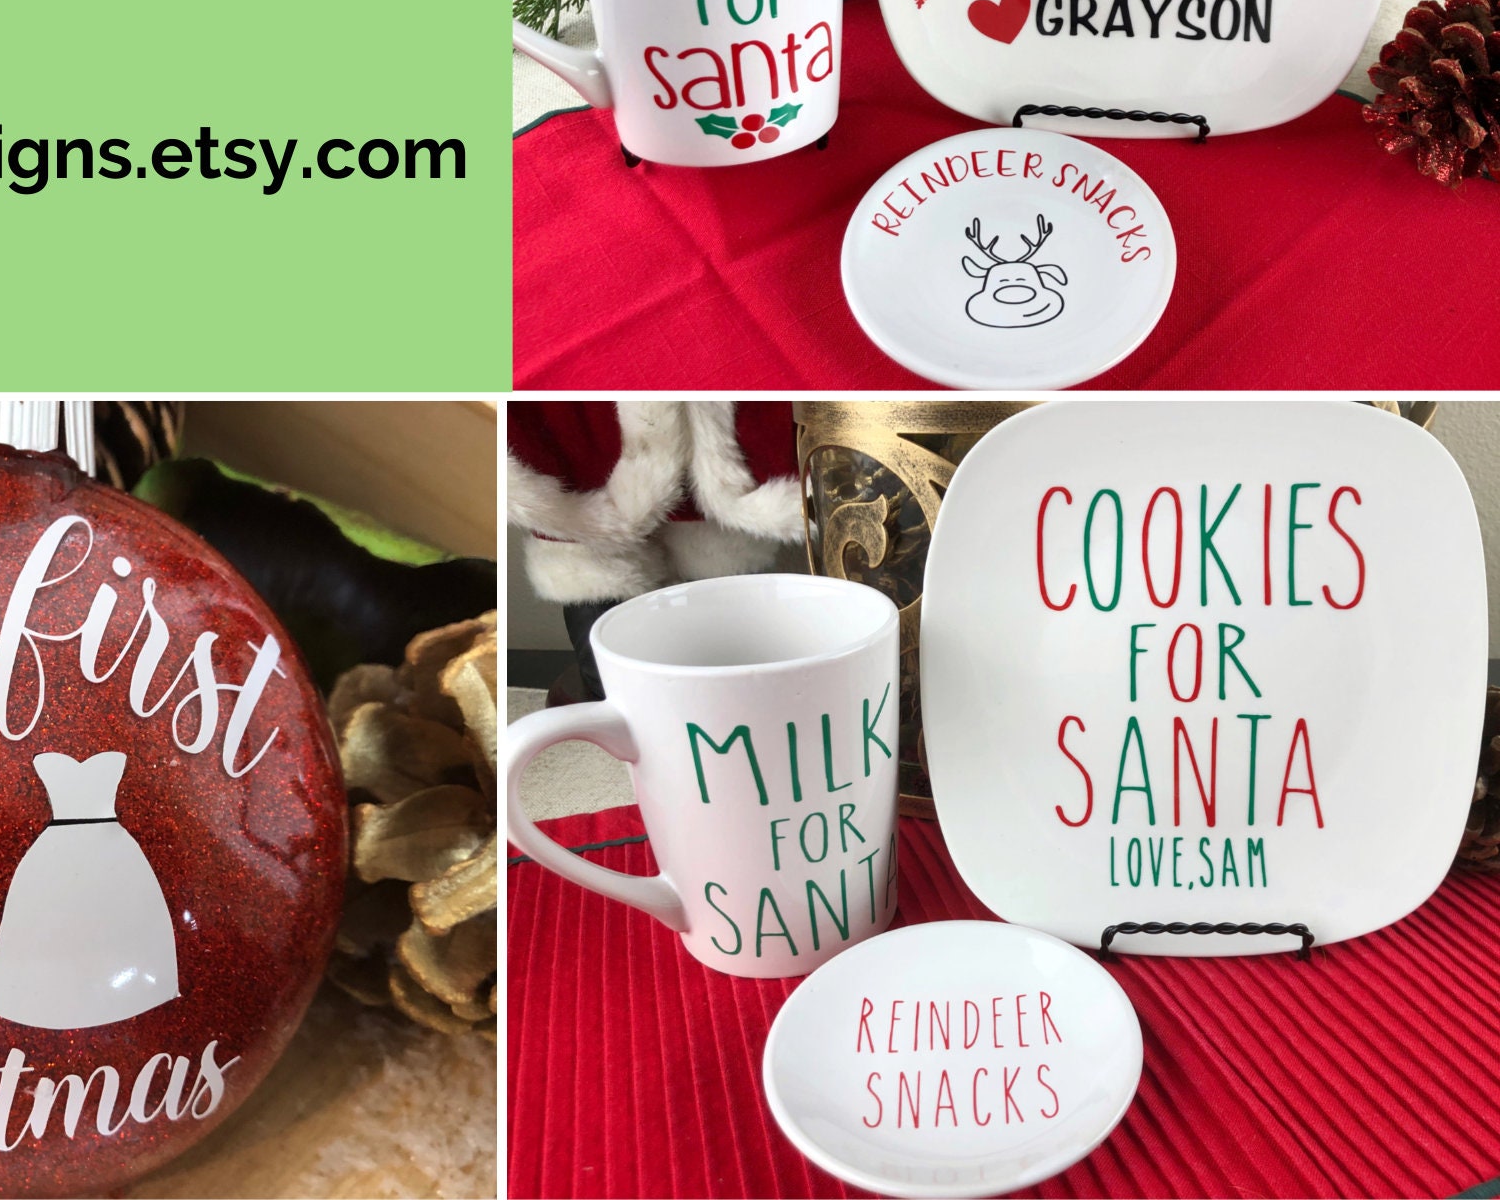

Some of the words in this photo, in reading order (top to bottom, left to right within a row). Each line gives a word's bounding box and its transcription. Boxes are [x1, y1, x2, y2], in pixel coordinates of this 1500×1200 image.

[643, 21, 833, 111] santa
[871, 149, 1043, 237] REINDEER
[1052, 163, 1151, 263] SNACKS
[1037, 483, 1365, 612] COOKIES
[1130, 622, 1262, 703] FOR
[686, 682, 892, 806] MILK
[1055, 714, 1325, 829] SANTA
[771, 803, 866, 871] FOR
[704, 832, 898, 958] SANTA
[856, 991, 1063, 1054] REINDEER
[862, 1064, 1060, 1129] SNACKS
